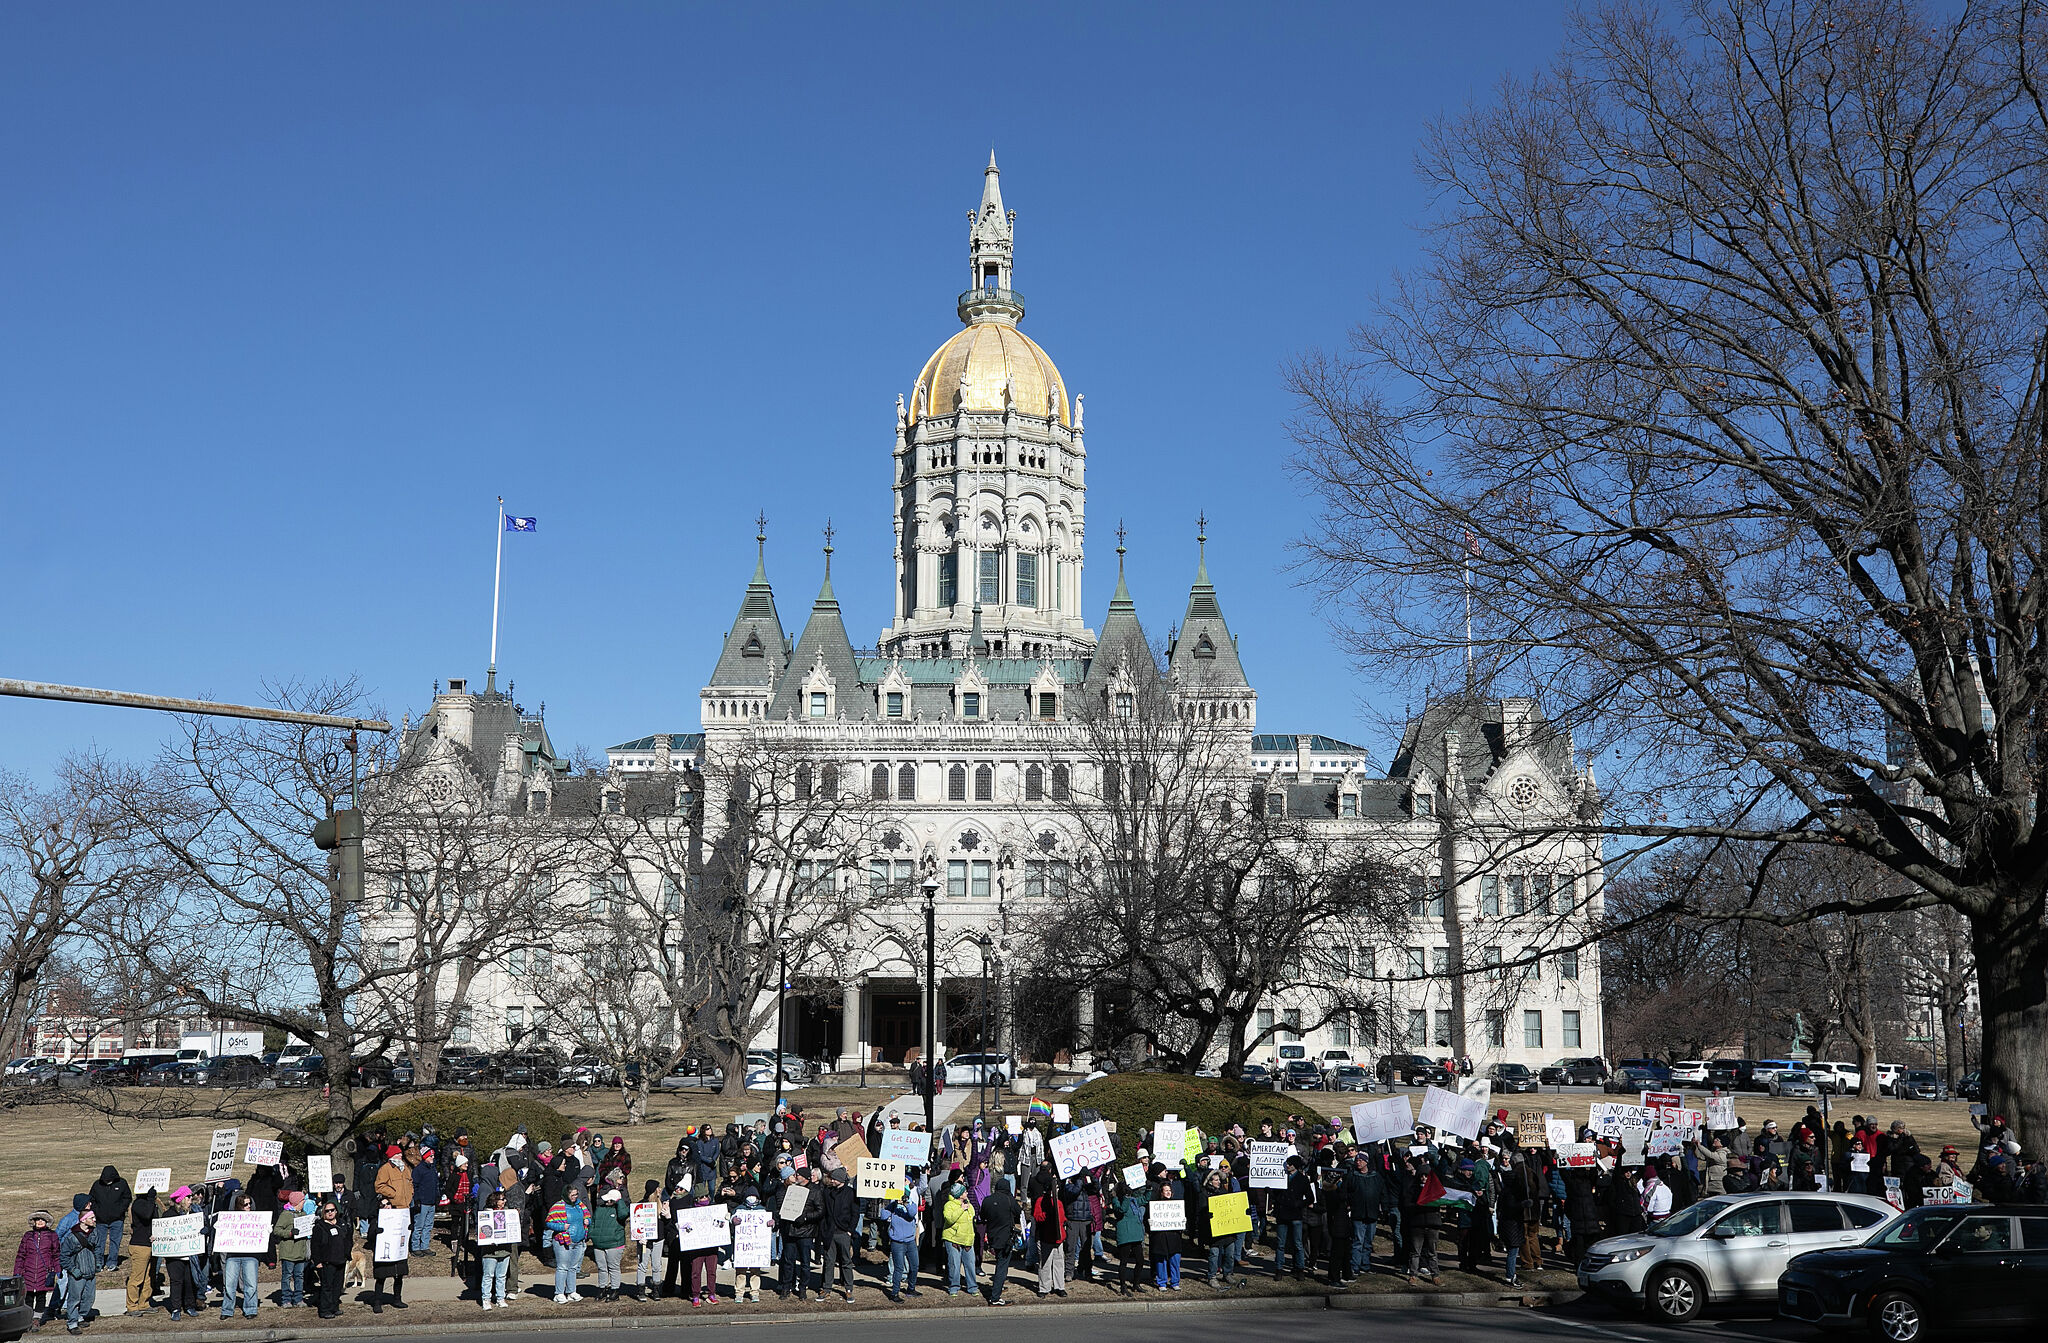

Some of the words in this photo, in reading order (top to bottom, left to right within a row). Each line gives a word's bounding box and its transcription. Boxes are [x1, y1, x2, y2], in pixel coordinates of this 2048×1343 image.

[1647, 1095, 1679, 1104] Trumpism
[1354, 1100, 1401, 1124] RULE
[1608, 1104, 1624, 1116] NO
[1628, 1106, 1650, 1118] ONE
[1520, 1112, 1544, 1123] DENY
[1617, 1116, 1642, 1126] VOTED
[1664, 1108, 1702, 1127] STOP
[1358, 1122, 1378, 1138] OF
[1384, 1115, 1412, 1133] LAW
[1520, 1124, 1546, 1134] DEFEND
[1603, 1126, 1621, 1136] FOR
[891, 1134, 903, 1143] Get
[906, 1136, 922, 1144] ELON
[1058, 1126, 1098, 1145] REJECT
[1520, 1134, 1546, 1143] DEPOSE
[248, 1140, 264, 1150] HATE
[266, 1141, 282, 1150] DOES
[1058, 1136, 1106, 1158] PROJECT
[1252, 1144, 1288, 1154] AMERICANS
[211, 1148, 235, 1160] DOGE
[1062, 1145, 1111, 1174] 2025
[258, 1156, 278, 1164] GREAT
[210, 1160, 232, 1172] Coup!
[866, 1162, 896, 1172] STOP
[864, 1179, 896, 1190] MUSK
[1926, 1188, 1953, 1199] STOP
[1154, 1202, 1165, 1211] GET
[1166, 1202, 1180, 1210] MUSK
[1215, 1196, 1237, 1208] PEOPLE
[1220, 1210, 1233, 1218] OVER
[1216, 1218, 1239, 1230] PROFIT
[736, 1225, 758, 1236] JUST
[153, 1242, 172, 1253] MORE
[174, 1242, 184, 1252] OF
[188, 1238, 200, 1250] US!
[736, 1253, 770, 1267] RIGHTS
